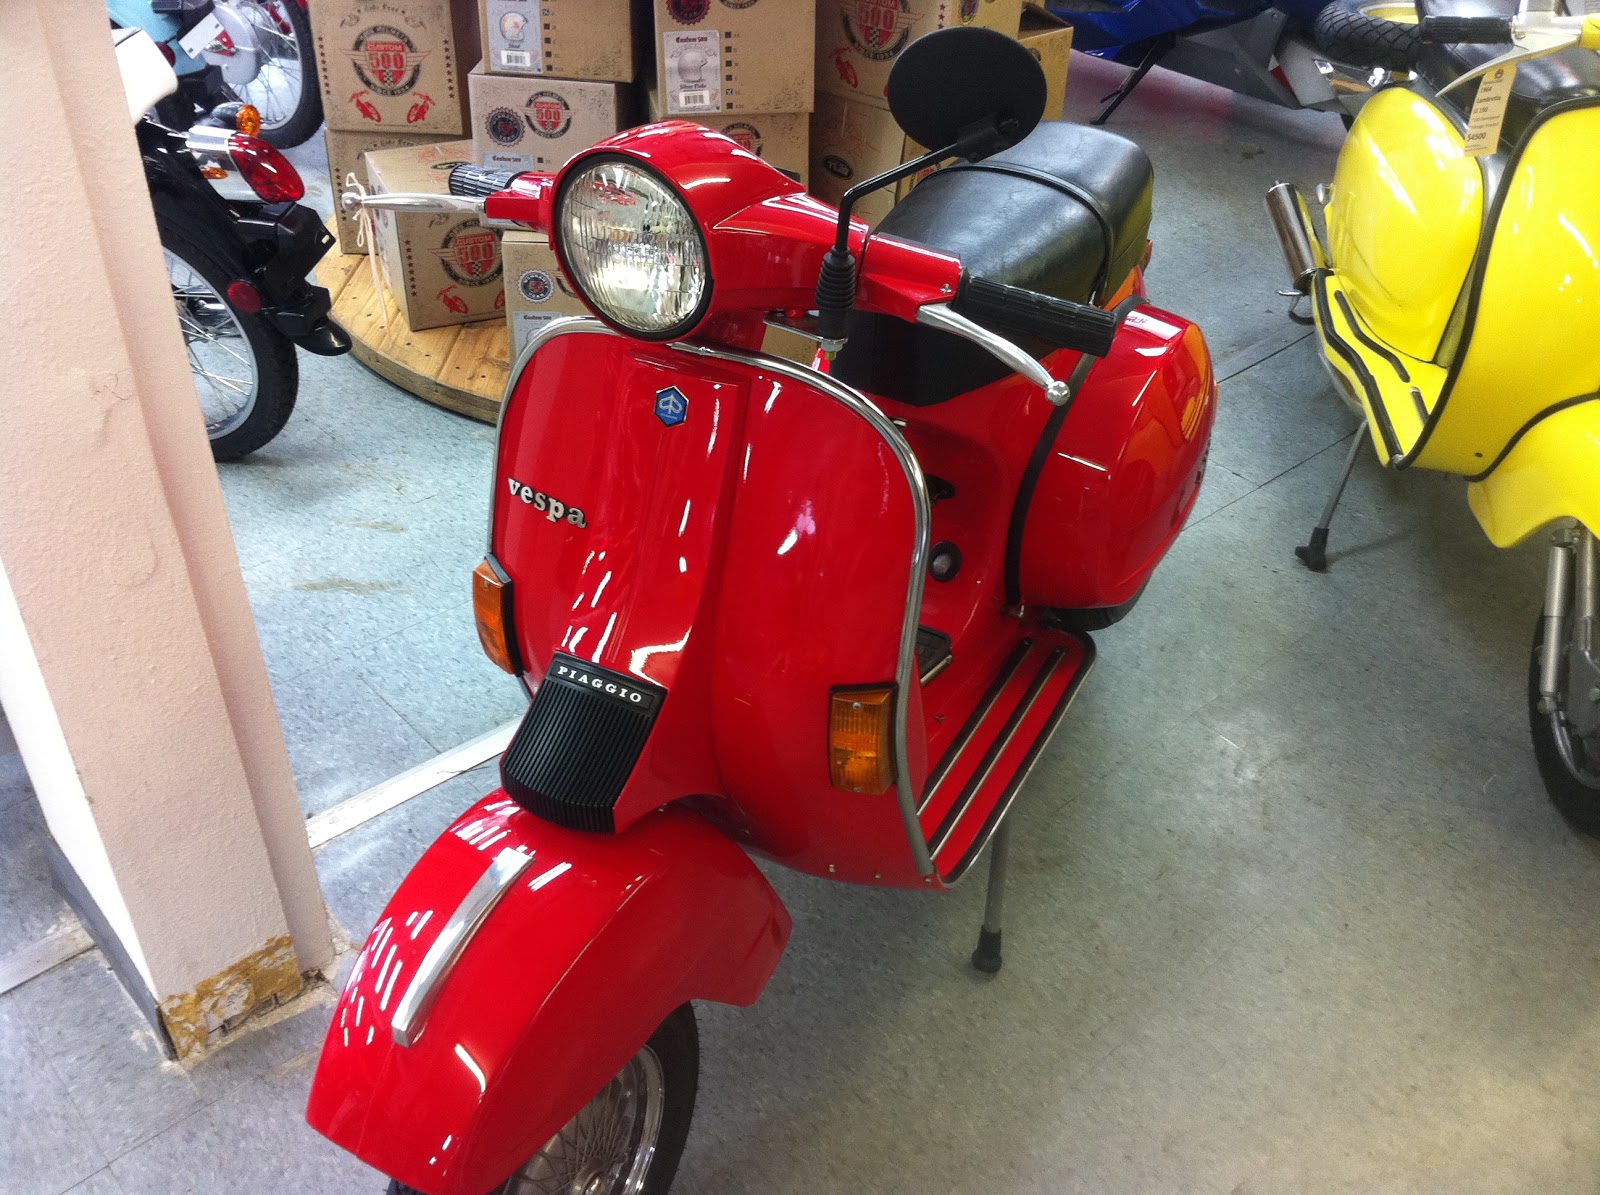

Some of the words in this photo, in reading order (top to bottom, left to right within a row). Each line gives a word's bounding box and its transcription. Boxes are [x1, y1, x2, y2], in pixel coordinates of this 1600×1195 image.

[369, 52, 405, 69] 500
[536, 109, 561, 120] 500
[1467, 132, 1487, 142] $4500
[456, 234, 492, 246] CUSTOM
[459, 244, 493, 263] 500
[508, 477, 587, 529] vespa
[557, 665, 642, 703] PIAGGIO
